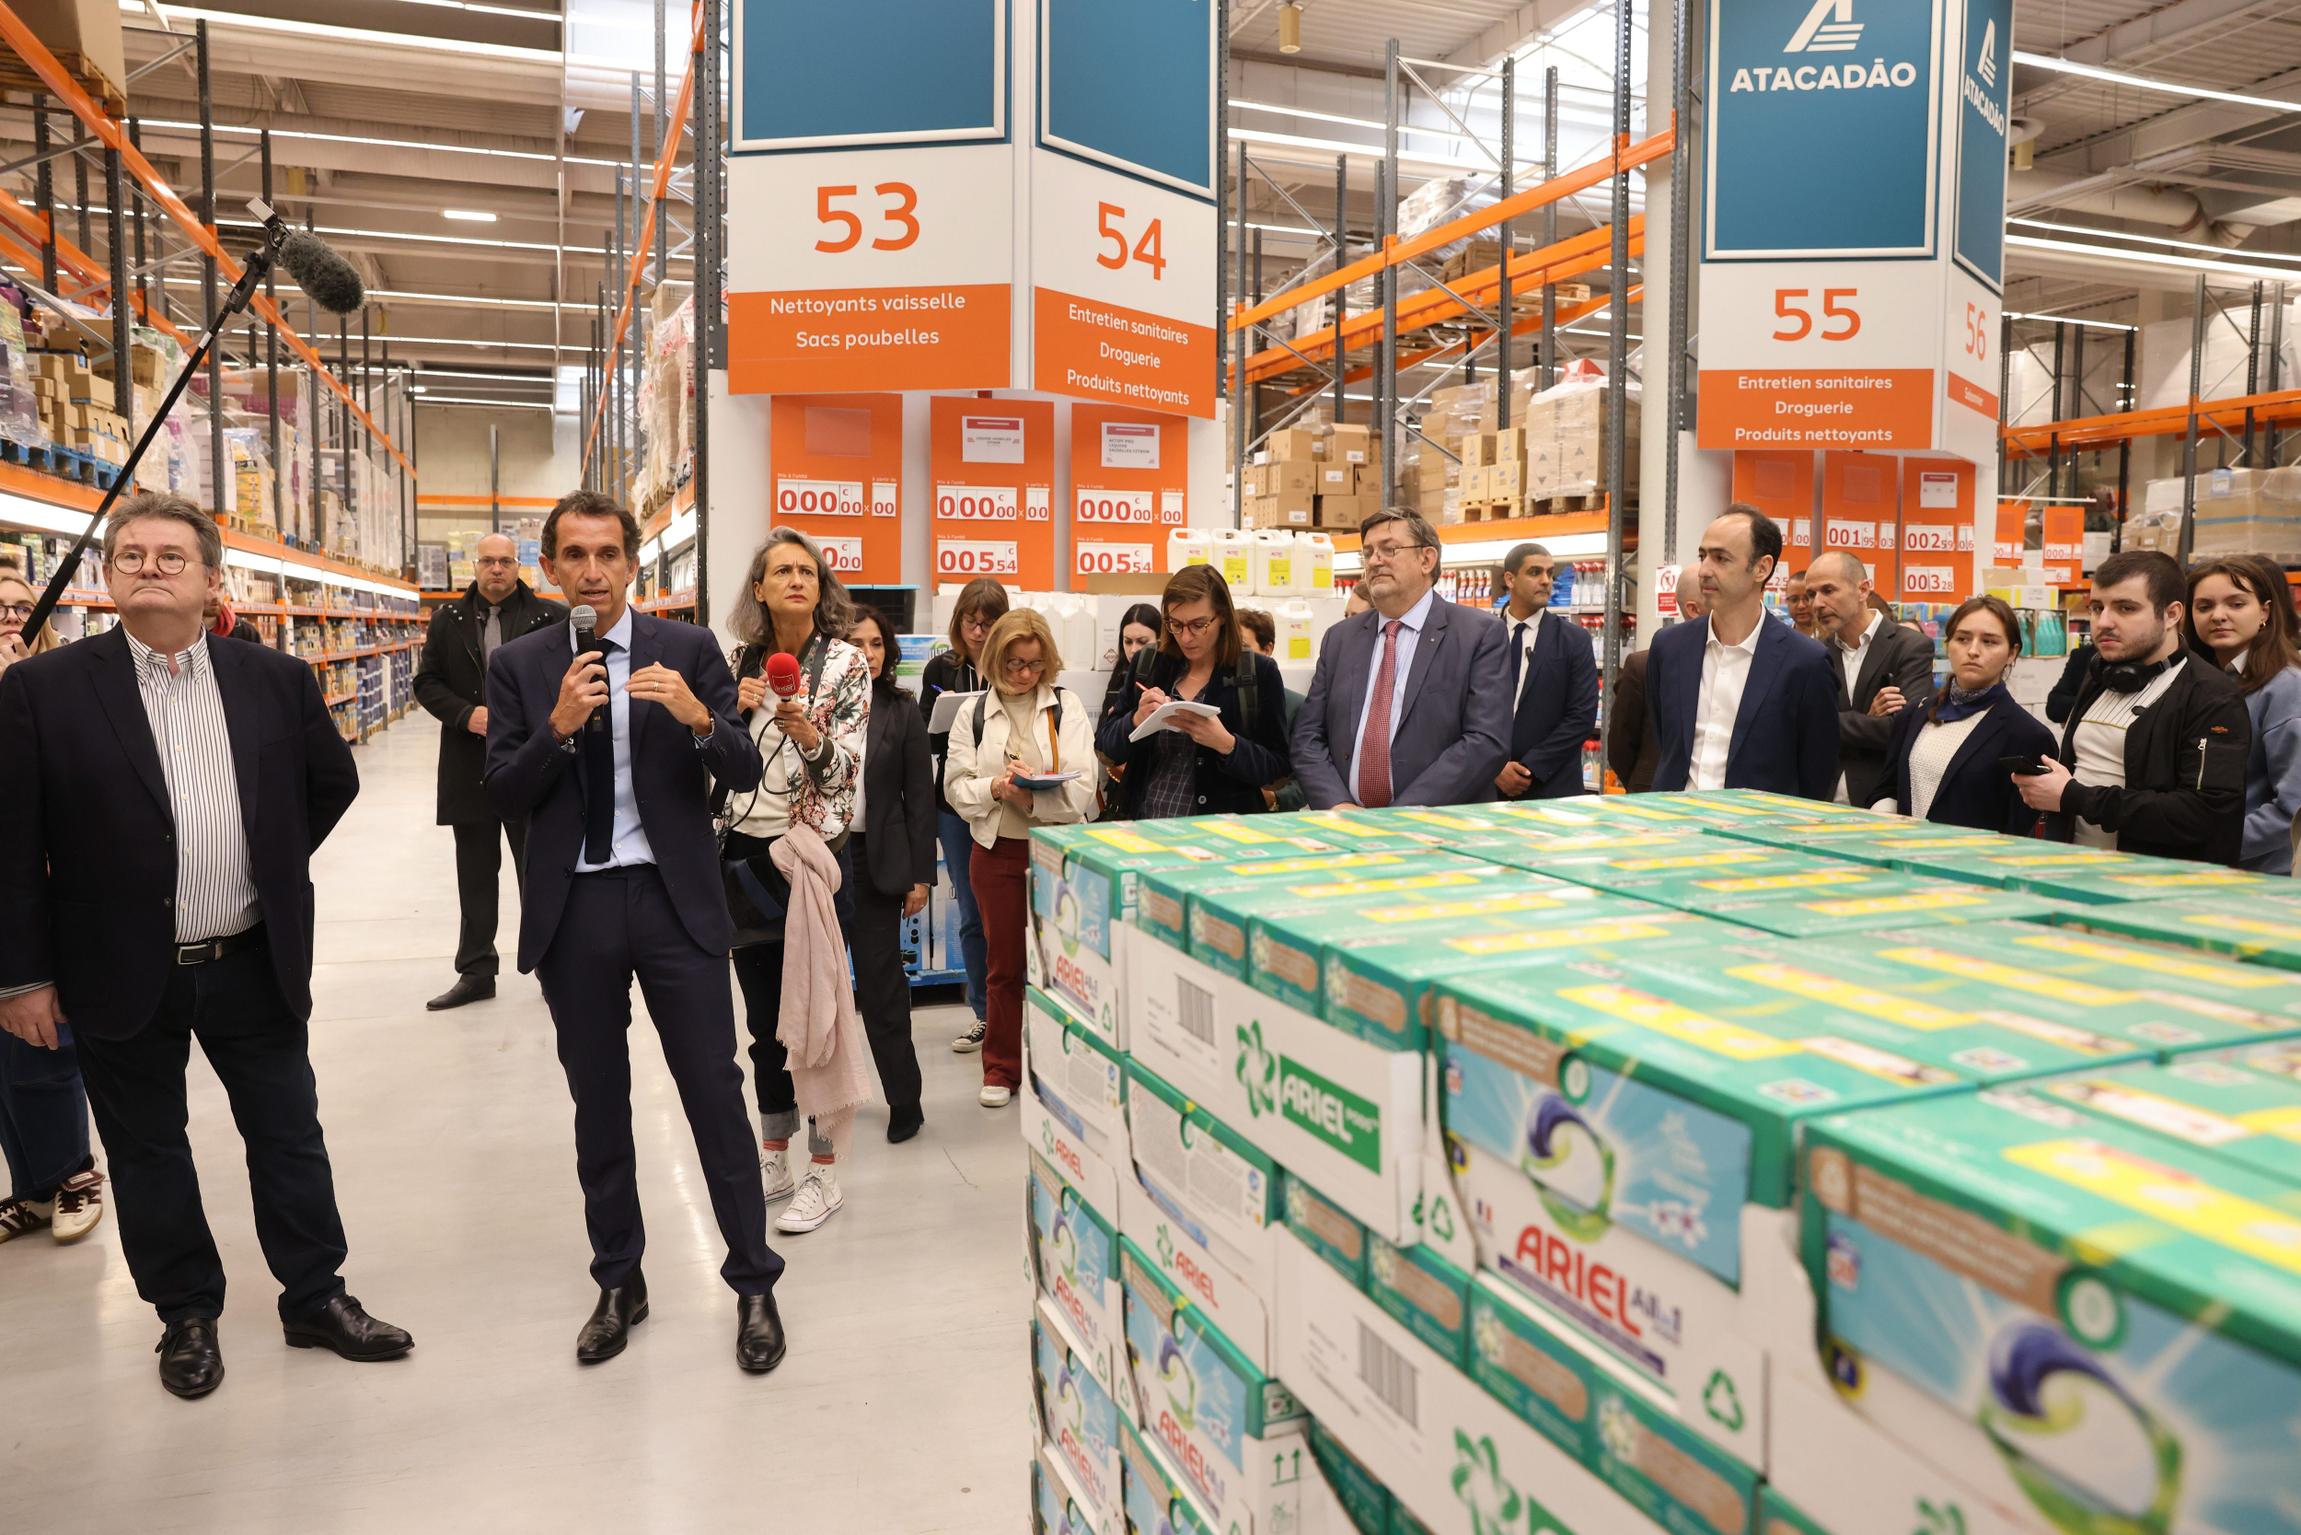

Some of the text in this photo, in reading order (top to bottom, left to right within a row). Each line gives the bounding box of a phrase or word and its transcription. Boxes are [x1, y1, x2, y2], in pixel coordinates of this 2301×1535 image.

[815, 181, 920, 254] 53
[1096, 200, 1167, 281] 54
[770, 292, 966, 317] Nettoyants vaisselle
[1069, 303, 1189, 346] Entretien sanitaires
[1772, 287, 1862, 342] 55
[795, 328, 940, 351] Sacs poubelles
[1965, 302, 1987, 361] 56
[1099, 341, 1161, 369] Droguerie
[1067, 369, 1190, 407] Produits nettoyants
[1738, 375, 1893, 390] Entretien sanitaires
[1775, 401, 1854, 418] Droguerie
[1734, 427, 1893, 445] Produits nettoyants
[874, 502, 895, 515] 00
[1027, 506, 1048, 518] 00
[1163, 510, 1181, 522] 00
[1828, 528, 1860, 546] 001
[1907, 532, 1940, 549] 002
[1907, 574, 1940, 590] 003
[1056, 954, 1089, 1002] ARIEL
[1283, 1073, 1353, 1144] ARIEL
[1055, 1139, 1085, 1181] ARIEL
[1175, 1250, 1219, 1309] ARIEL
[1515, 1224, 1642, 1338] ARIEL
[1056, 1275, 1089, 1335] ARIEL
[1061, 1427, 1097, 1494] ARIEL
[1160, 1409, 1211, 1494] ARIEL
